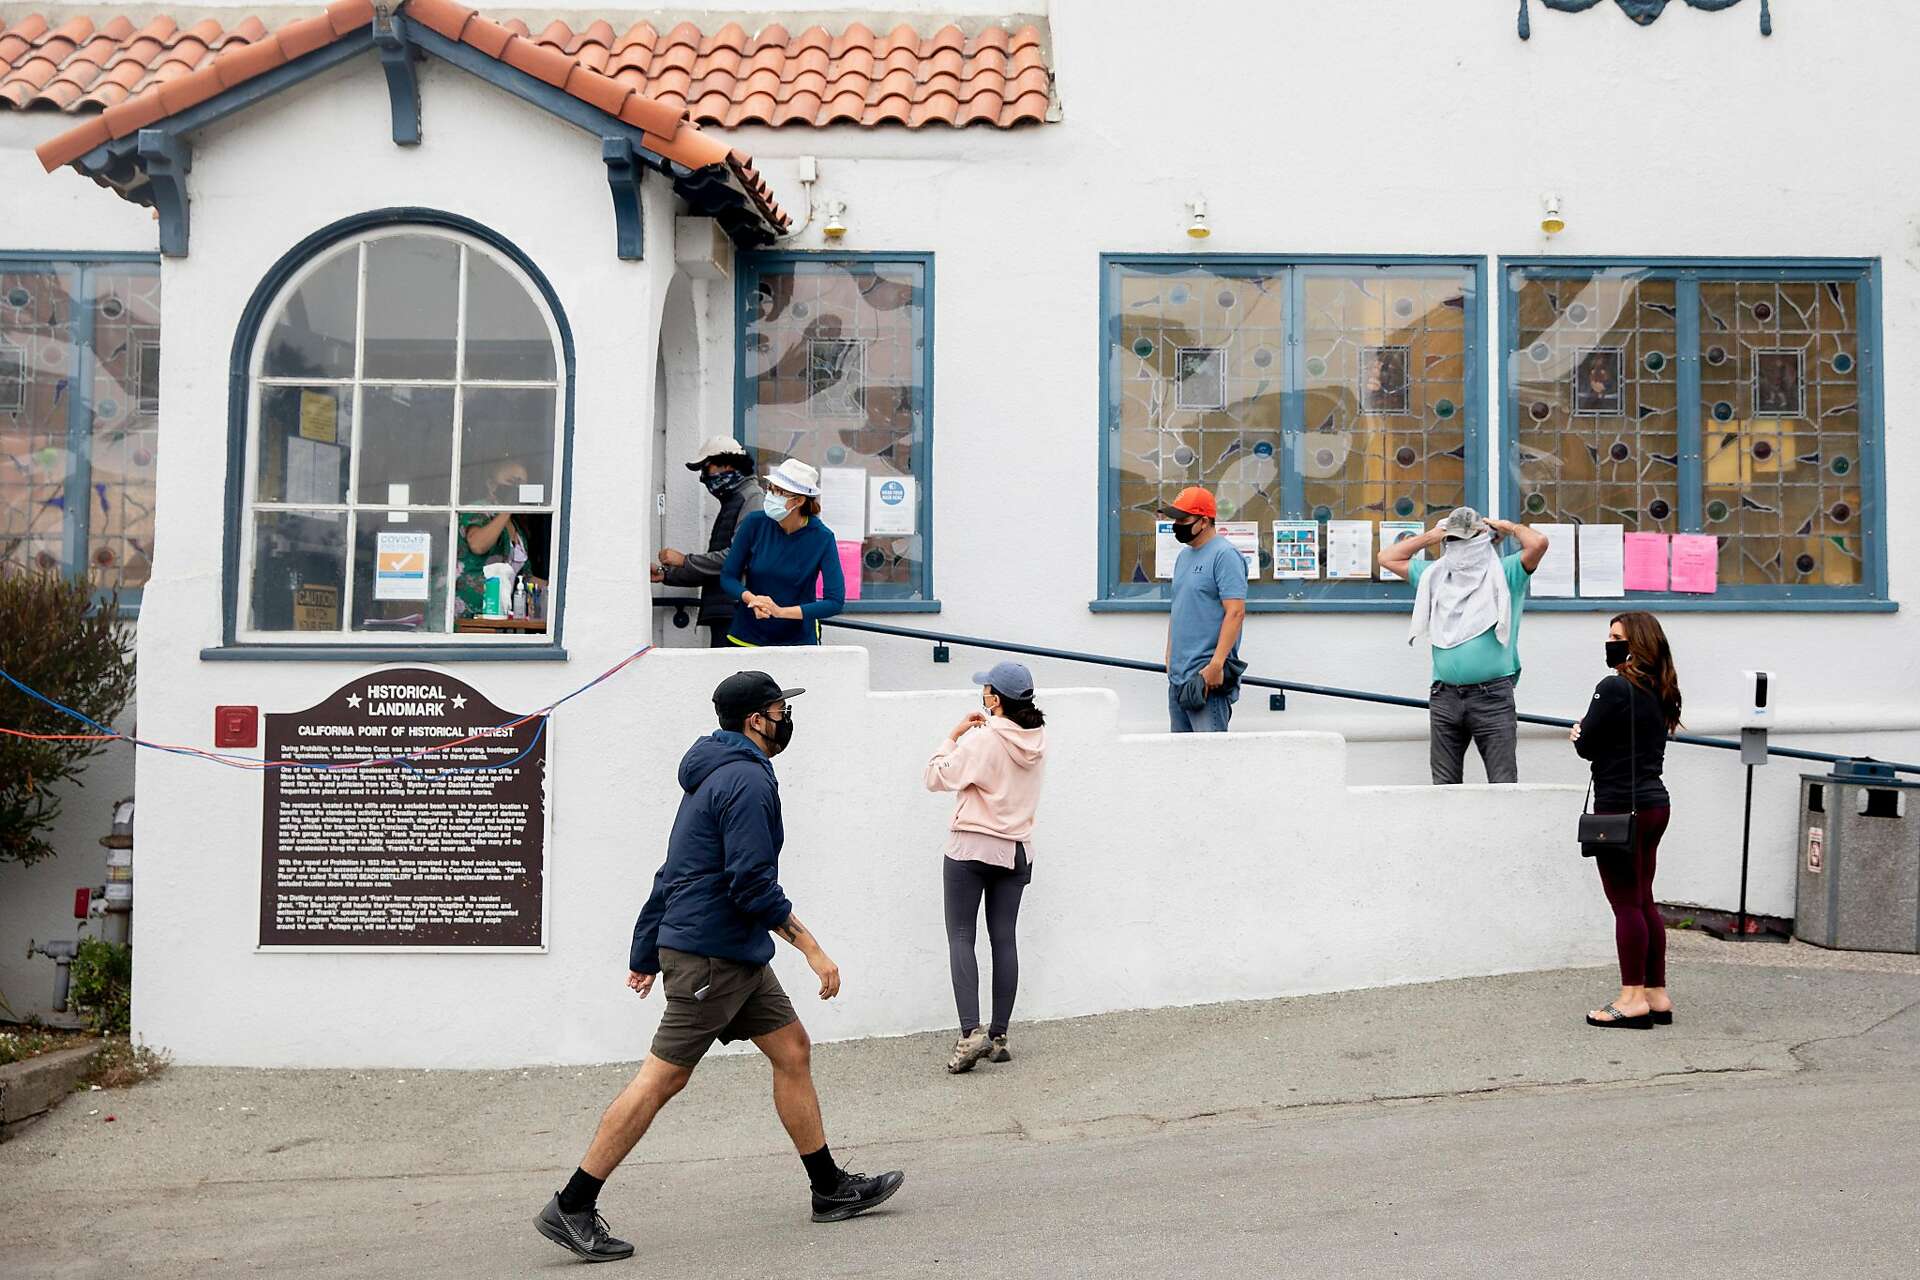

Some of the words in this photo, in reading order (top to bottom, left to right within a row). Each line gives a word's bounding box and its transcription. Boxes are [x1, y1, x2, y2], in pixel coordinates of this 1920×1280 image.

[367, 685, 446, 700] HISTORICAL
[368, 702, 444, 716] LANDMARK
[298, 725, 354, 736] CALIFORNIA
[358, 726, 387, 736] POINT
[391, 726, 405, 736] OF
[408, 726, 464, 737] HISTORICAL
[468, 726, 514, 737] INTEREST
